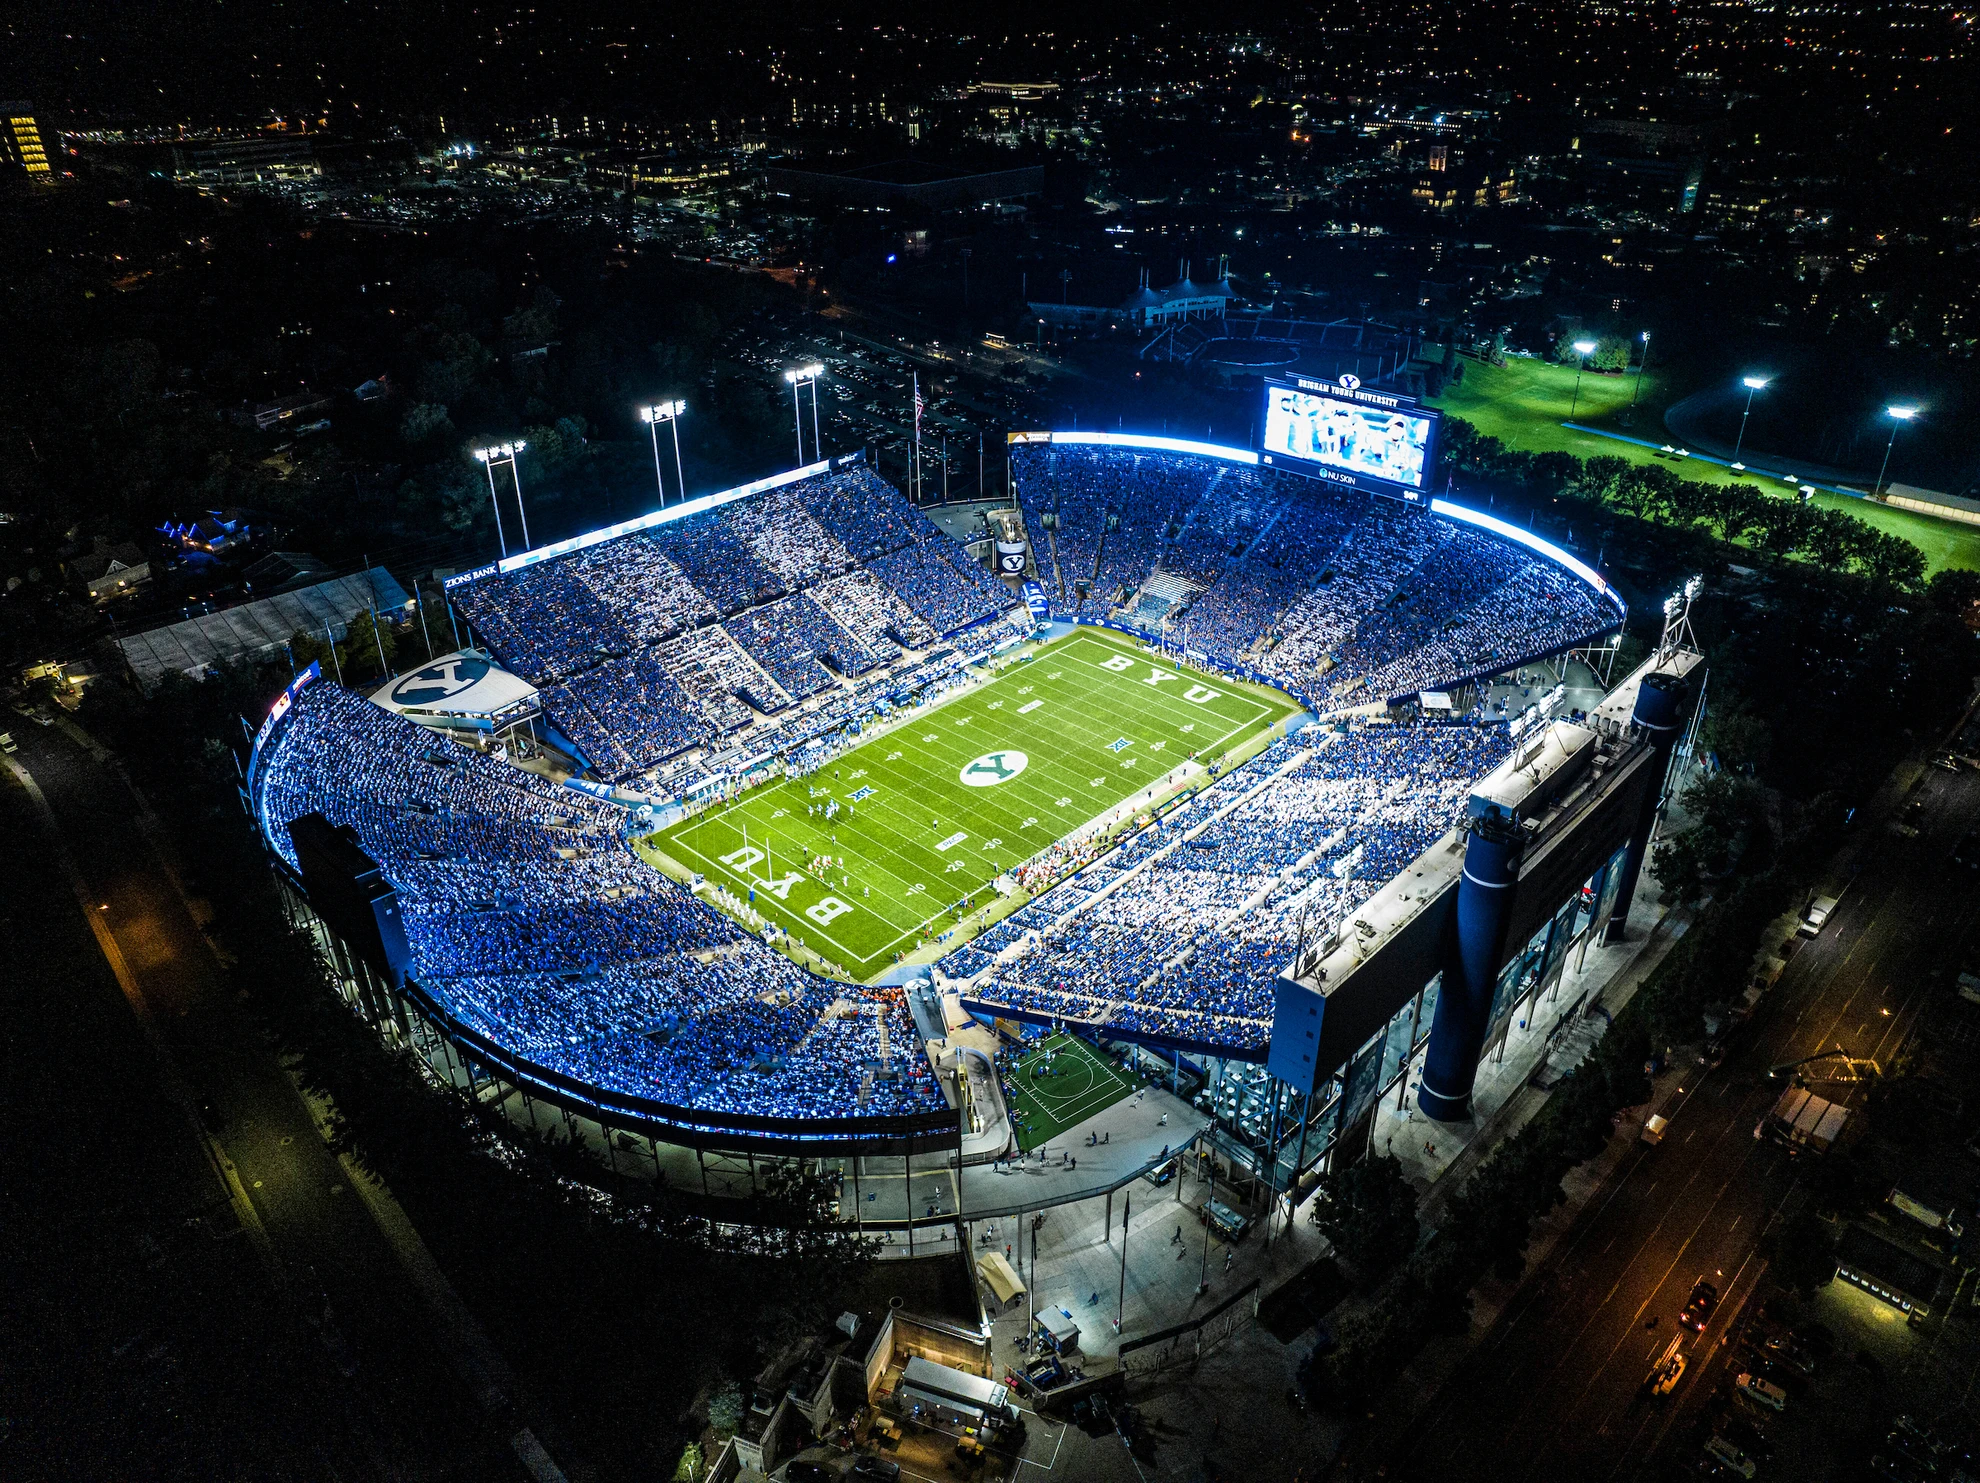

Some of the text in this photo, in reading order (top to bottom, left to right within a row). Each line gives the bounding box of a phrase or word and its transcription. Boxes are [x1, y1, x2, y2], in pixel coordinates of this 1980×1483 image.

[1343, 376, 1357, 388] Y
[1298, 379, 1399, 407] BRIGHAM YOUNG UNIVERSITY
[1328, 471, 1356, 485] NU SKIN
[1005, 556, 1023, 570] Y
[445, 565, 497, 588] ZIONS BANK
[1099, 655, 1222, 703] BYU
[1017, 686, 1033, 695] 20
[922, 733, 939, 743] 50
[966, 754, 1015, 779] Y
[852, 769, 868, 779] 30
[1055, 797, 1072, 807] 50
[1022, 817, 1039, 827] 40
[942, 833, 965, 848] PACS
[985, 838, 1003, 849] 30
[947, 860, 966, 872] 20
[718, 846, 855, 927] BYU
[908, 883, 926, 894] 10
